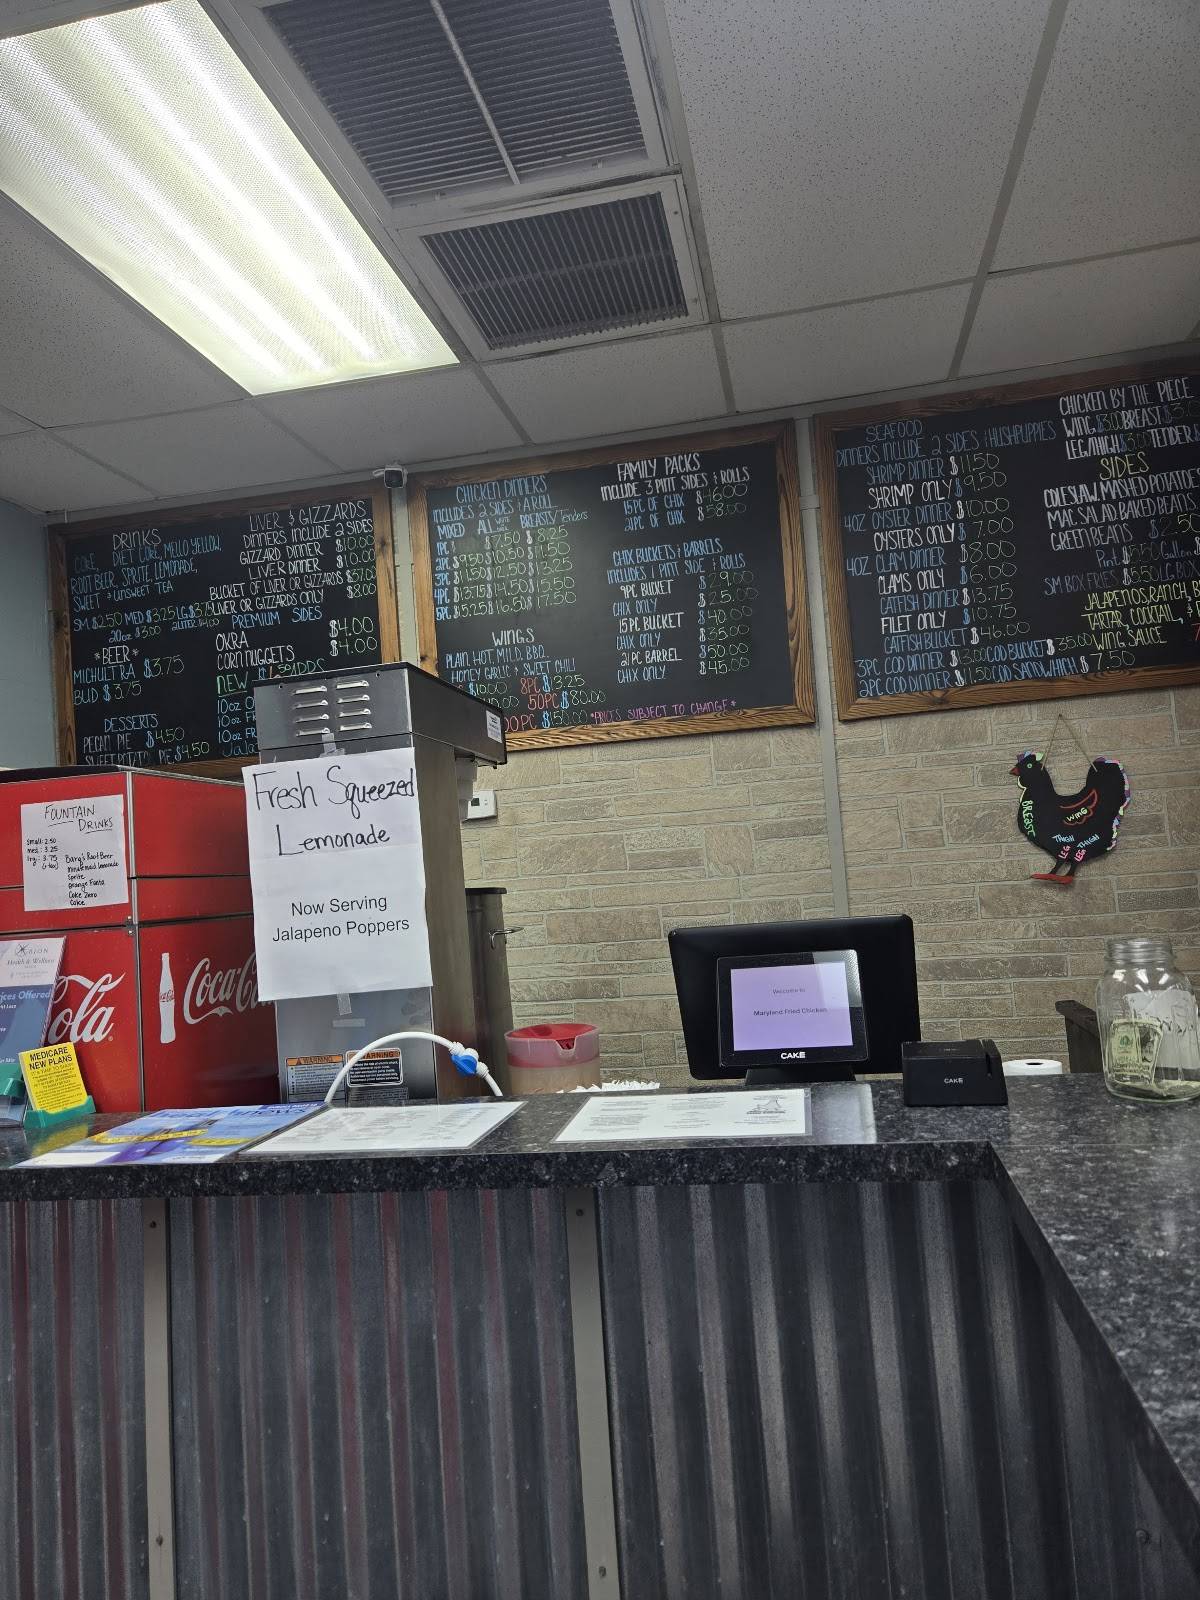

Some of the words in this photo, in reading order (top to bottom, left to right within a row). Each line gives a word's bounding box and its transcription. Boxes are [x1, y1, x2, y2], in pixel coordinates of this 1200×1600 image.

[1059, 390, 1107, 416] CHICKEN
[1109, 387, 1125, 408] BY
[1157, 377, 1194, 402] PIECE
[865, 419, 923, 442] SEAFOOD
[837, 445, 880, 467] DINNERS
[882, 438, 925, 461] INCLUDE
[931, 436, 942, 456] 2
[946, 430, 979, 453] SIDES
[617, 458, 657, 482] FAMILY
[665, 453, 700, 475] PACKS
[867, 464, 905, 485] SHRIMP
[909, 457, 946, 481] DINNER
[1099, 451, 1150, 481] SIDES
[504, 475, 547, 497] DINNERS
[601, 482, 641, 501] INCLUDE
[646, 481, 653, 495] 3
[655, 477, 677, 494] PINT
[681, 473, 708, 490] SIDES
[721, 466, 750, 484] ROLLS
[868, 483, 914, 510] SHRIMP
[921, 479, 953, 501] ONLY
[249, 513, 282, 531] LIVER
[299, 501, 367, 525] GIZZARDS
[479, 505, 487, 518] 2
[490, 500, 514, 517] SIDES
[872, 507, 911, 529] OYSTER
[916, 502, 954, 525] DINNER
[113, 529, 161, 550] DRINKS
[243, 531, 287, 548] DINNERS
[291, 525, 331, 541] INCLUDE
[335, 523, 344, 536] 2
[347, 519, 373, 533] SIDES
[437, 523, 465, 539] MIXED
[873, 527, 923, 552] OYSTERS
[926, 523, 954, 545] ONLY
[1050, 528, 1091, 551] GREEN
[1090, 523, 1133, 547] BEANS
[240, 548, 281, 565] GIZZARD
[286, 542, 324, 559] DINNER
[636, 544, 676, 563] BUCKETS
[684, 538, 723, 558] BARRELS
[876, 553, 906, 574] CLAM
[910, 546, 946, 569] DINNER
[248, 565, 286, 580] LIVER
[288, 559, 321, 574] DINNER
[435, 572, 450, 586] 3PC
[155, 581, 173, 594] TEA
[209, 583, 245, 600] BUCKET
[250, 581, 262, 595] OF
[263, 579, 286, 593] LIVER
[289, 577, 300, 591] OR
[304, 572, 343, 588] GIZZARDS
[641, 580, 673, 597] BUCKET
[878, 572, 911, 595] CLAMS
[917, 568, 945, 590] ONLY
[240, 597, 252, 612] OR
[256, 594, 297, 609] GIZZARDS
[300, 589, 324, 605] ONLY
[880, 594, 919, 615] CATFISH
[923, 589, 960, 609] DINNER
[232, 611, 280, 629] PREMIUM
[292, 606, 323, 623] SIDES
[643, 612, 684, 631] BUCKET
[881, 614, 912, 634] FILET
[917, 610, 946, 630] ONLY
[216, 631, 248, 651] OKRA
[329, 616, 373, 637] $4.00
[492, 628, 535, 647] WINGS
[1091, 630, 1125, 650] WING
[1128, 626, 1168, 647] SAUCE
[330, 637, 377, 656] $4.00
[645, 648, 682, 664] BARREL
[451, 669, 481, 684] HONEY
[523, 661, 551, 676] SWEET
[618, 667, 639, 684] CHIX
[643, 665, 666, 681] ONLY
[73, 689, 98, 705] BUD
[528, 693, 559, 710] 50PC
[628, 704, 667, 720] SUBJECT
[672, 705, 684, 716] TO
[104, 714, 158, 733] DESSERTS
[117, 733, 131, 750] PIE
[253, 771, 318, 810] Fresh
[327, 765, 415, 819] Squeezed
[45, 804, 95, 821] FOUNTAIN
[79, 817, 113, 831] DRINKS
[276, 823, 390, 856] Lemonade
[1058, 845, 1071, 859] LEG
[1074, 849, 1086, 862] LEG
[291, 901, 324, 916] Now
[329, 895, 387, 912] Serving
[273, 925, 341, 942] Jalapeno
[346, 918, 410, 935] Poppers
[773, 987, 797, 995] Welcome
[753, 1007, 783, 1017] Maryland
[785, 1007, 801, 1015] Fried
[801, 1006, 827, 1015] Chicken
[29, 1046, 68, 1062] MEDICARE
[29, 1061, 47, 1070] NEW
[48, 1054, 73, 1066] PLANS
[780, 1051, 806, 1060] CAKE
